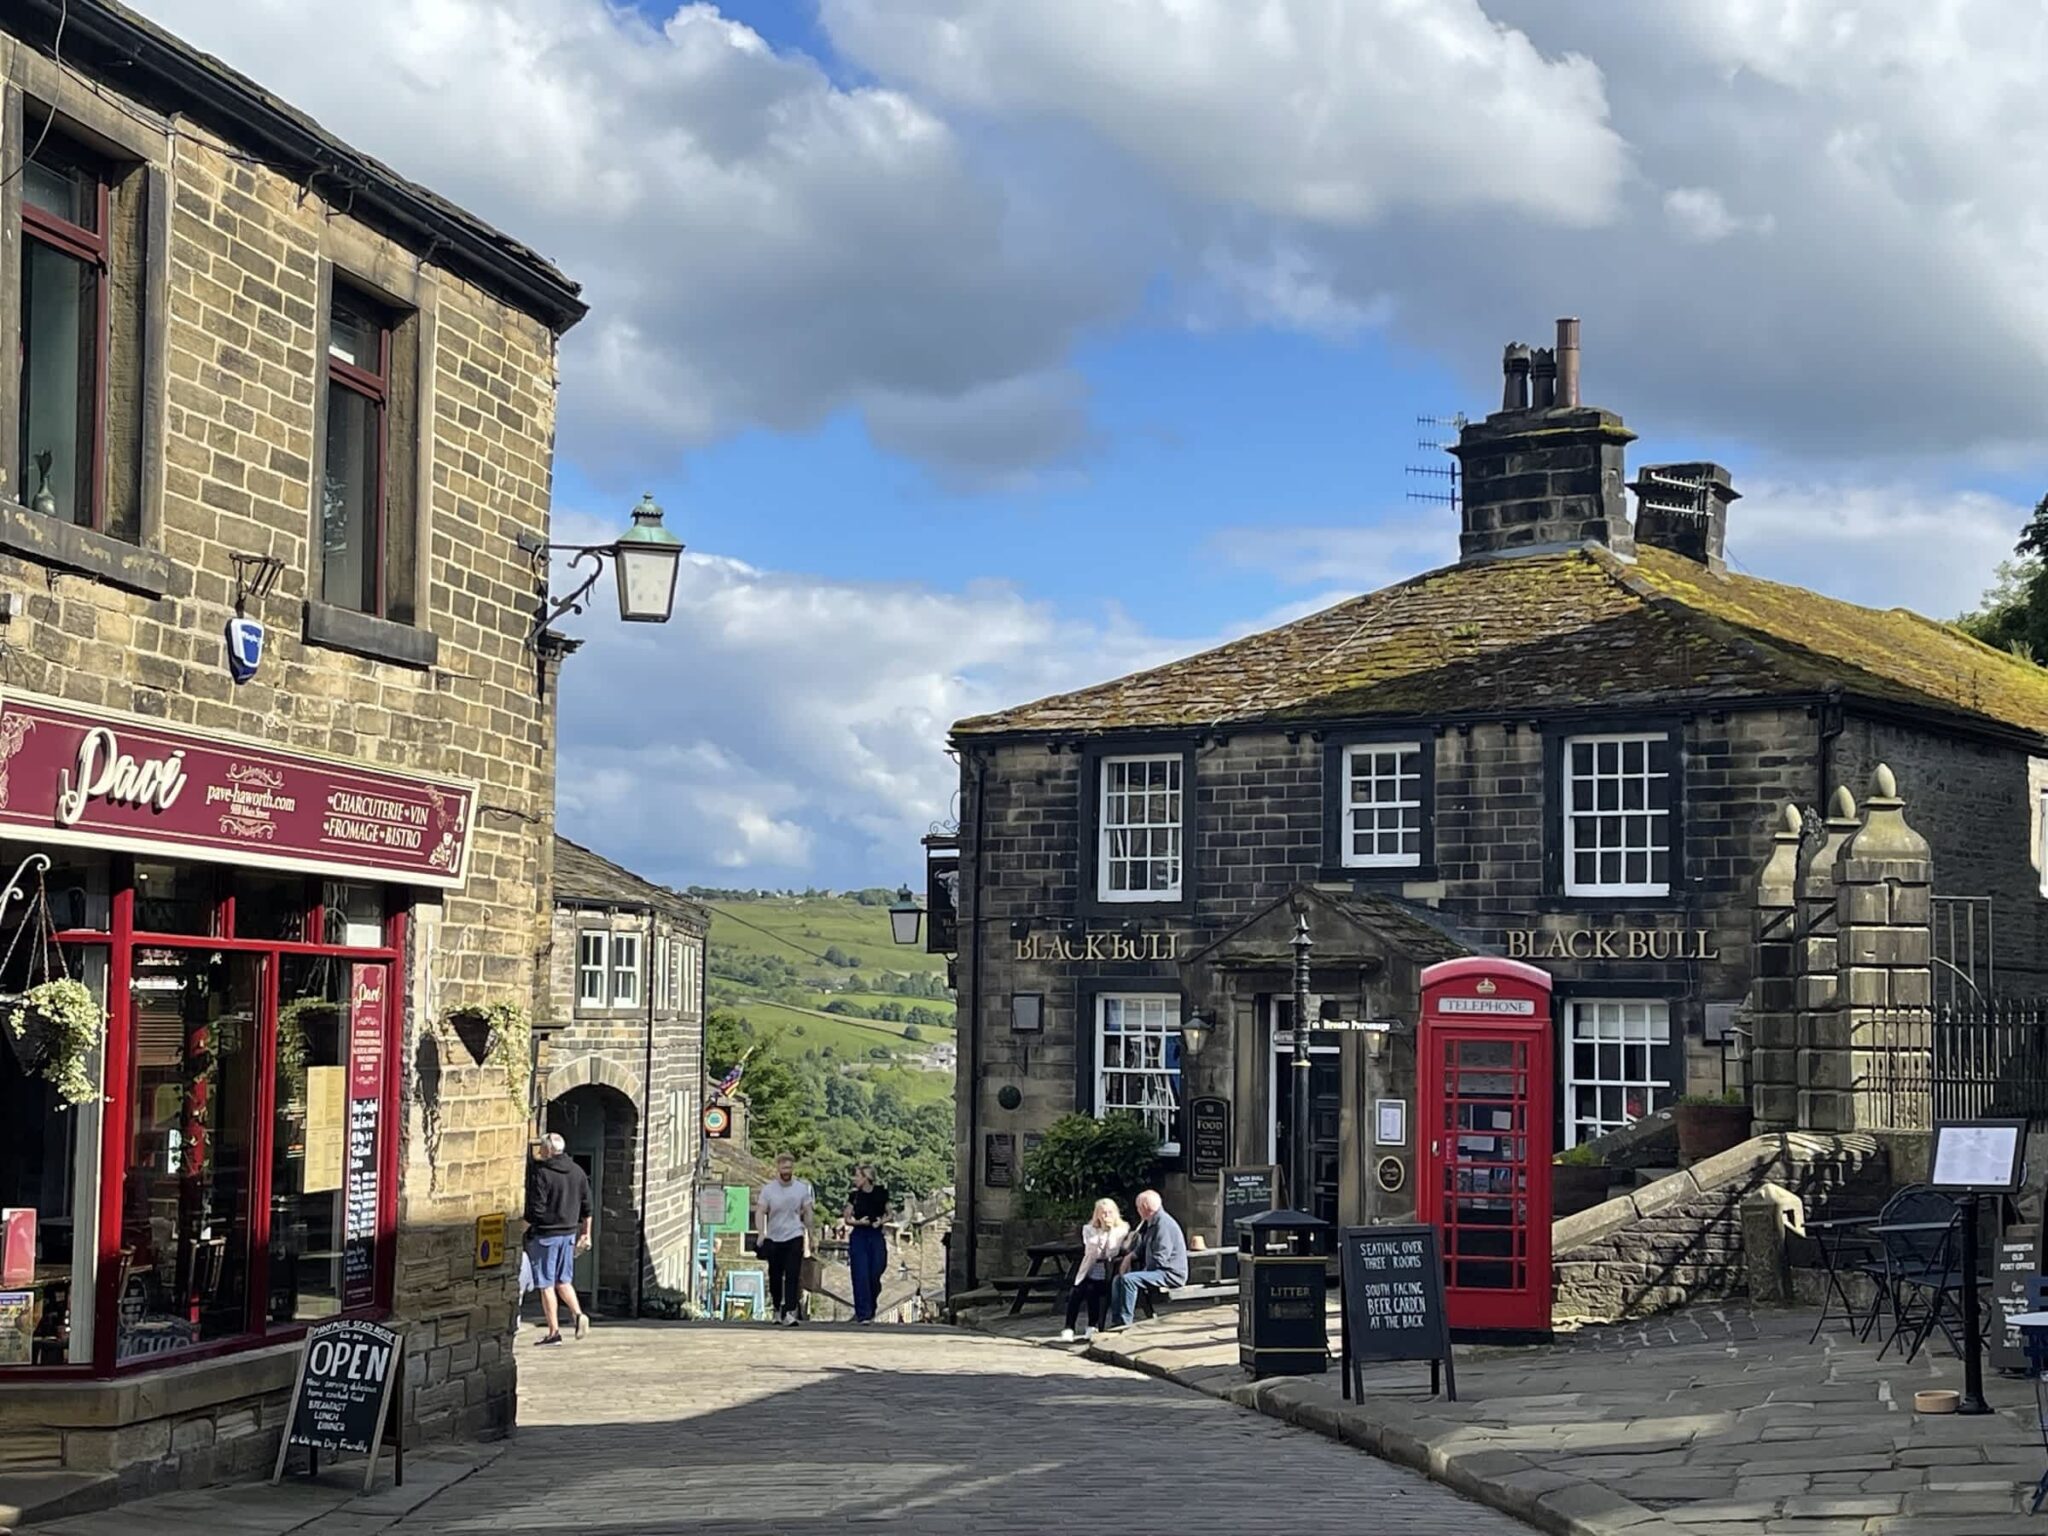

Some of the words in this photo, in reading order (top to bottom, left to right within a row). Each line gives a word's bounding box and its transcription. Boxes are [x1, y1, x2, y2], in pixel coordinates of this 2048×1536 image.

[205, 783, 296, 812] pave-haworth.com
[1015, 934, 1107, 961] BLACK
[1507, 929, 1620, 959] BLACK
[1627, 929, 1719, 960] BULL
[1447, 999, 1527, 1013] TELEPHONE
[1197, 1120, 1223, 1130] FOOD
[1360, 1242, 1399, 1256] SEATING
[1402, 1240, 1423, 1254] OVER
[1363, 1256, 1386, 1270] THREE
[1393, 1255, 1421, 1269] ROOMS
[1270, 1286, 1312, 1297] LITTER
[1365, 1283, 1390, 1297] SOUTH
[1393, 1281, 1423, 1295] FACING
[1367, 1297, 1392, 1315] BEER
[1393, 1296, 1426, 1314] GARDEN
[1370, 1316, 1380, 1329] AT
[1384, 1315, 1400, 1329] THE
[1402, 1314, 1424, 1328] BACK
[310, 1341, 390, 1382] OPEN
[308, 1400, 348, 1412] BREAKFAST
[314, 1411, 340, 1421] LUNCH
[317, 1421, 346, 1432] DINNER
